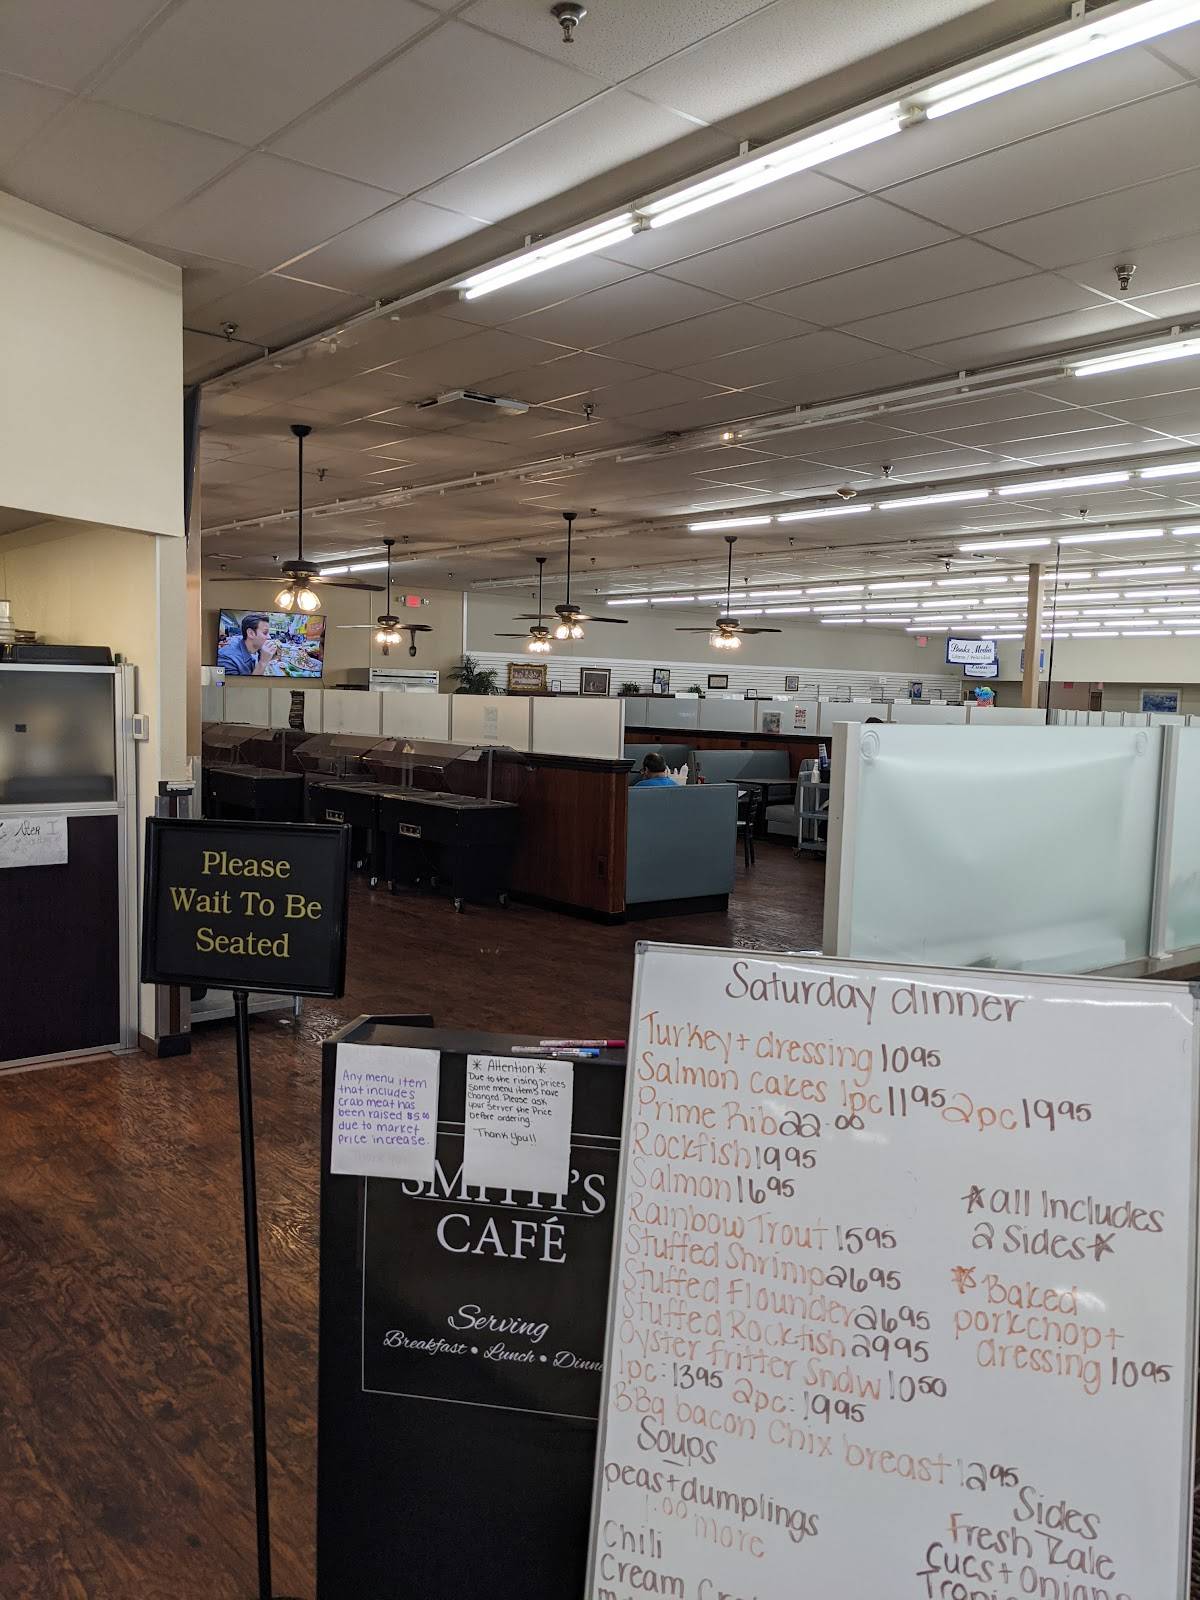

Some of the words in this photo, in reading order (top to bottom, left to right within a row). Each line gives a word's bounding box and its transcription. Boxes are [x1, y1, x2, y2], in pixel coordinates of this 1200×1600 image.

[201, 850, 291, 879] Please
[169, 886, 232, 914] Wait
[240, 891, 275, 917] To
[284, 894, 322, 920] Be
[196, 927, 290, 958] Seated
[725, 961, 876, 1025] Saturday
[892, 983, 1025, 1022] dinner
[342, 1069, 363, 1085] Any
[365, 1073, 394, 1083] menu
[399, 1078, 428, 1088] item
[468, 1072, 484, 1081] Due
[513, 1076, 538, 1089] rising
[487, 1059, 535, 1074] Attention
[638, 1051, 739, 1091] Salmon
[337, 1085, 364, 1095] that
[367, 1086, 416, 1100] includes
[366, 1099, 395, 1109] meat
[638, 1085, 716, 1129] Prime
[338, 1108, 365, 1117] been
[368, 1110, 403, 1120] raised
[338, 1121, 359, 1130] due
[361, 1121, 372, 1130] to
[376, 1123, 420, 1135] market
[473, 1127, 509, 1140] Thank
[632, 1121, 751, 1170] Rockfish
[630, 1156, 732, 1203] Salmon
[436, 1213, 567, 1264] CAFÉ
[629, 1191, 745, 1239] Rainbow
[748, 1211, 829, 1251] Trout
[972, 1222, 995, 1250] 2
[625, 1223, 720, 1268] Stuffed
[725, 1241, 824, 1296] Shrimp
[623, 1258, 720, 1304] Stuffed
[726, 1278, 853, 1328] Flounder
[982, 1274, 1078, 1316] Baked
[447, 1304, 550, 1344] Serving
[619, 1320, 701, 1361] Oyster
[622, 1290, 722, 1337] Stuffed
[730, 1309, 847, 1358] Rockfish
[383, 1329, 468, 1356] Breakfast
[483, 1341, 535, 1363] Lunch
[976, 1338, 1101, 1396] dressing
[637, 1415, 718, 1467] Soups
[676, 1395, 757, 1440] bacon
[844, 1433, 952, 1485] breast
[1013, 1486, 1101, 1540] Sides
[604, 1518, 663, 1559] Chili
[947, 1513, 1033, 1559] Fresh
[600, 1553, 685, 1600] Cream
